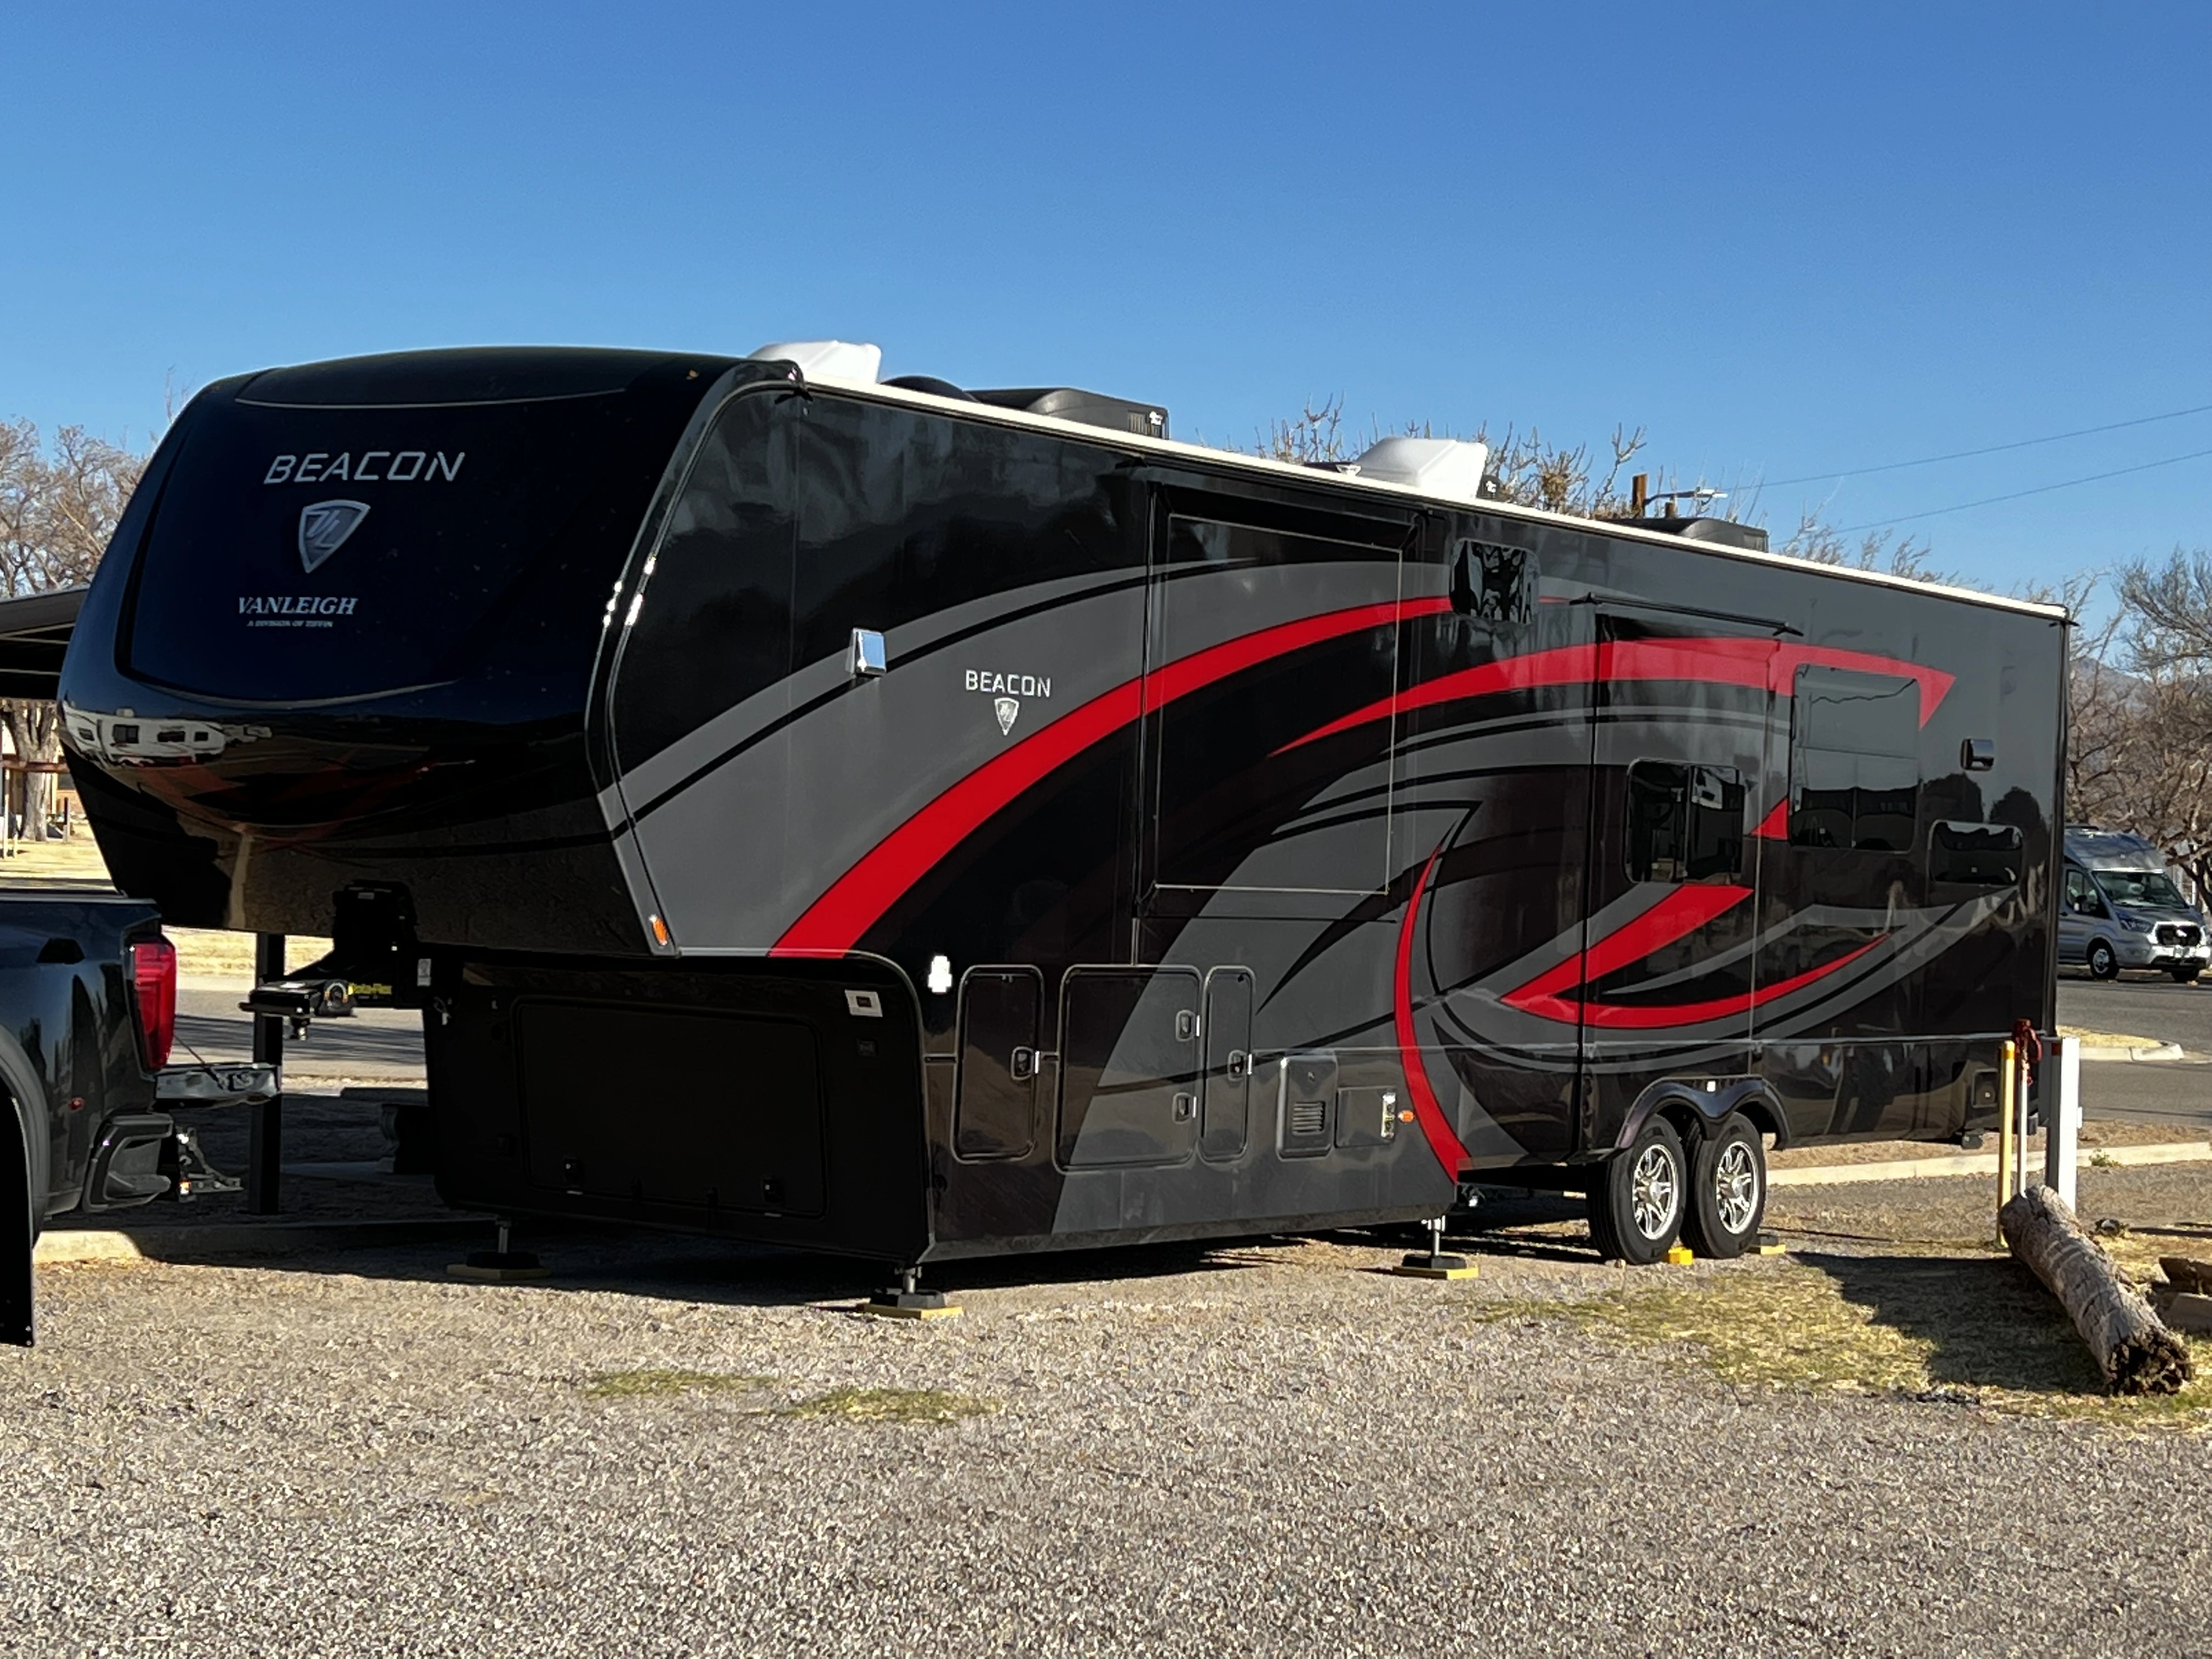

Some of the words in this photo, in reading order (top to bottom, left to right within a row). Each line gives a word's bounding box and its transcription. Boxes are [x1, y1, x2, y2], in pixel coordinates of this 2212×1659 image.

[263, 451, 466, 484] BEACON
[239, 596, 358, 615] VANLEIGH
[966, 669, 1051, 697] BEACON
